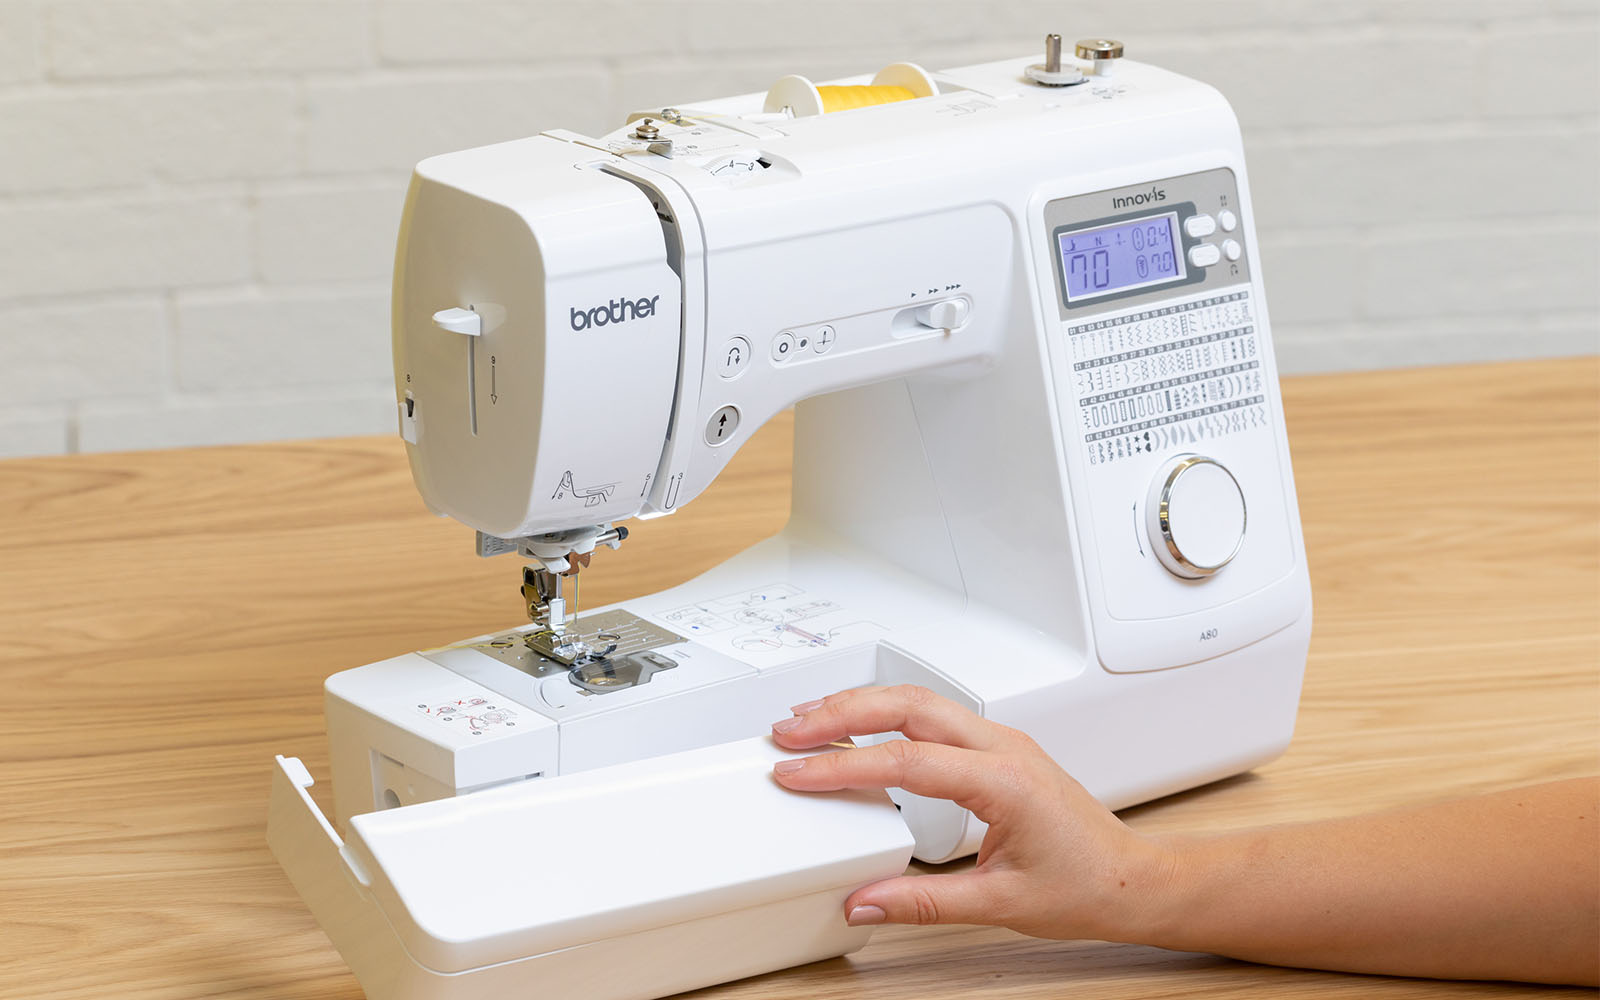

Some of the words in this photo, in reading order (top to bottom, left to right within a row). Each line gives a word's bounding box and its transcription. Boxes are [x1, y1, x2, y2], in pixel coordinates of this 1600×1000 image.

[729, 160, 734, 168] 4
[748, 162, 754, 171] 3
[1071, 250, 1109, 289] 70
[570, 295, 660, 332] brother
[491, 356, 496, 364] 9
[406, 374, 411, 382] 8
[1200, 628, 1218, 642] A80
